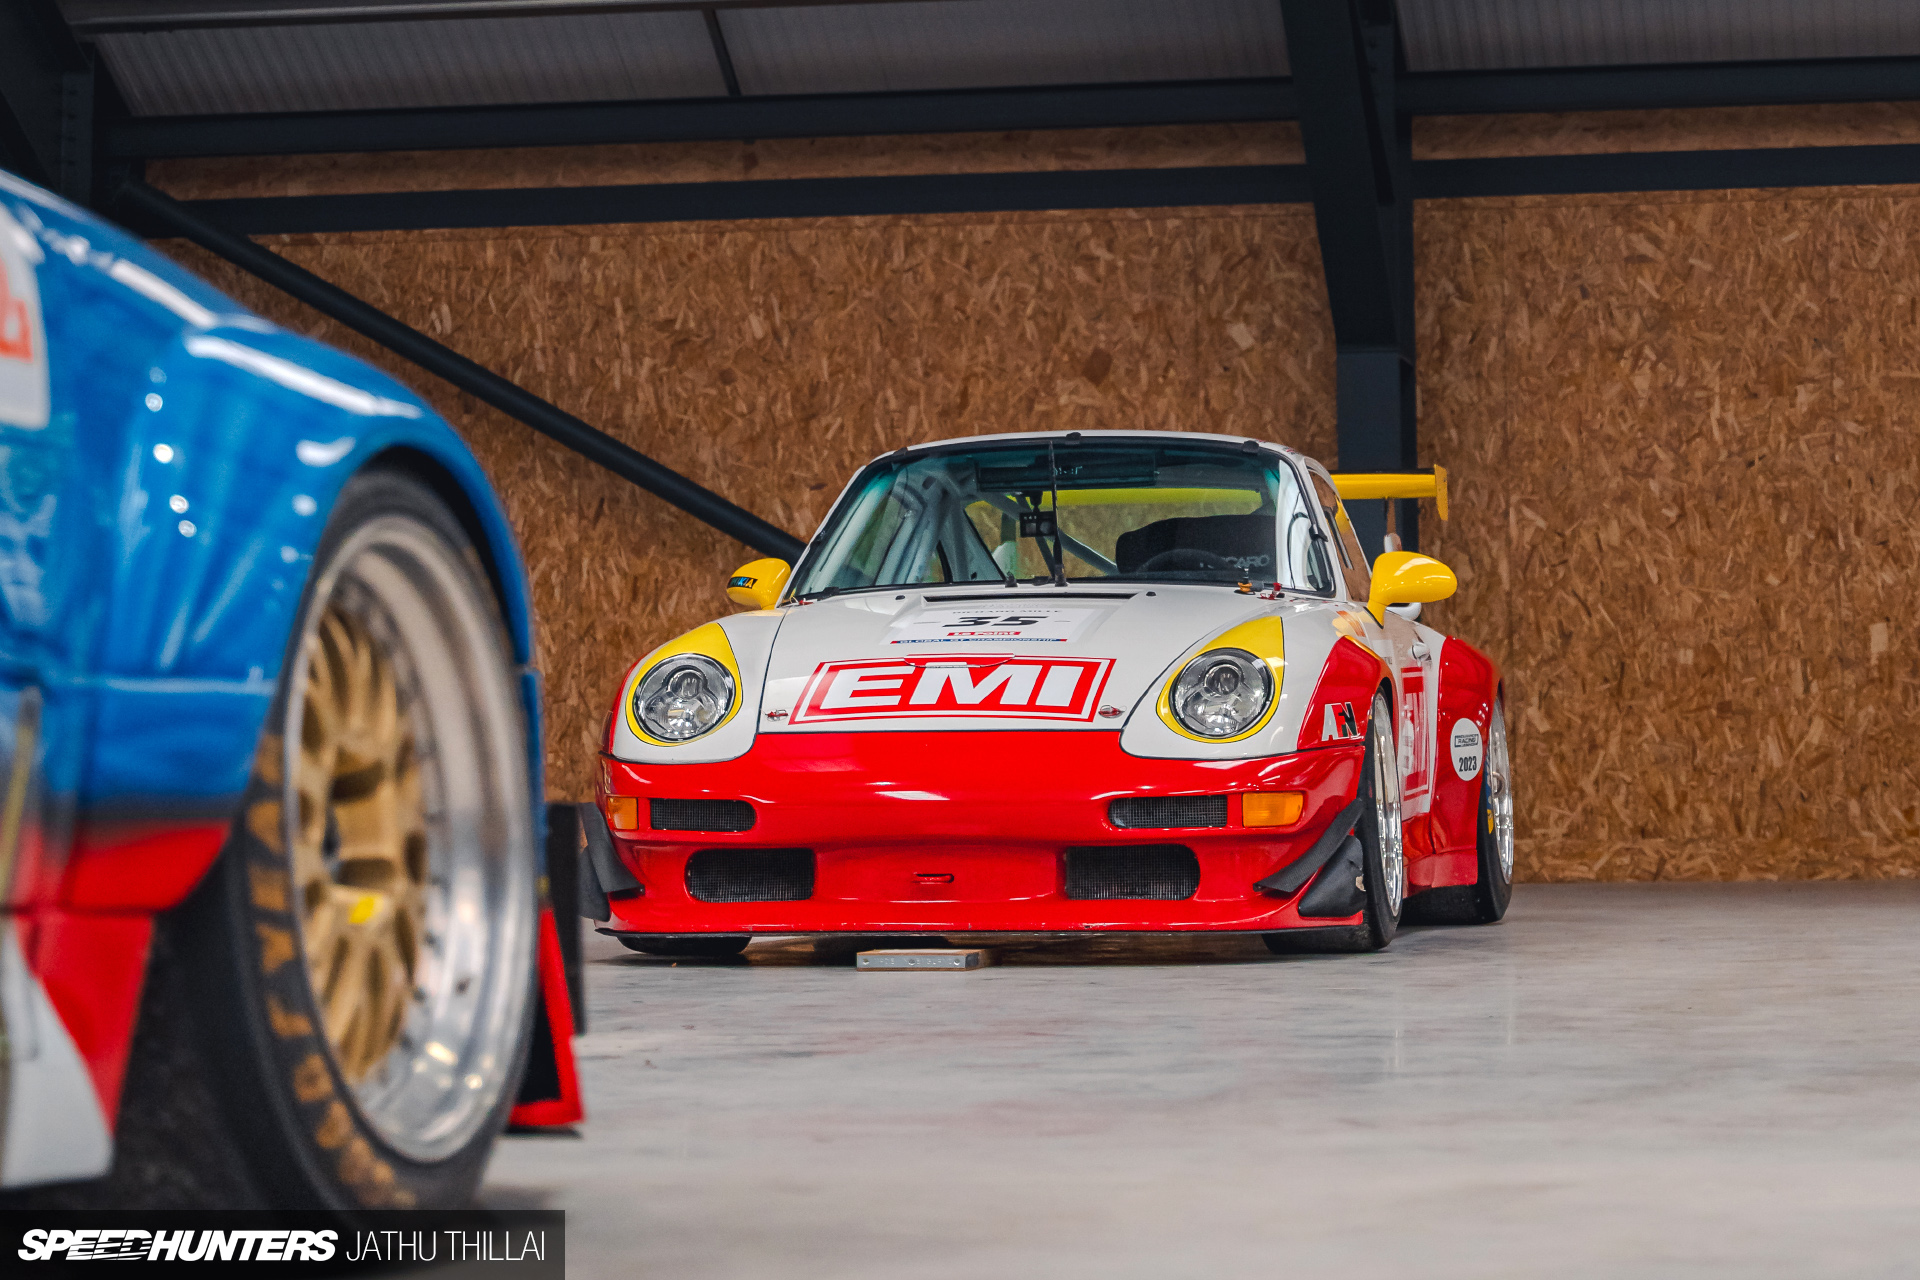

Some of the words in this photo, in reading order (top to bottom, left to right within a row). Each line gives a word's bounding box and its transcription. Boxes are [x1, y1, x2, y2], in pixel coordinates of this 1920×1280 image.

[941, 615, 1049, 628] 35
[819, 661, 1085, 709] EMI
[1321, 701, 1360, 741] AFN
[1458, 755, 1478, 772] 2023
